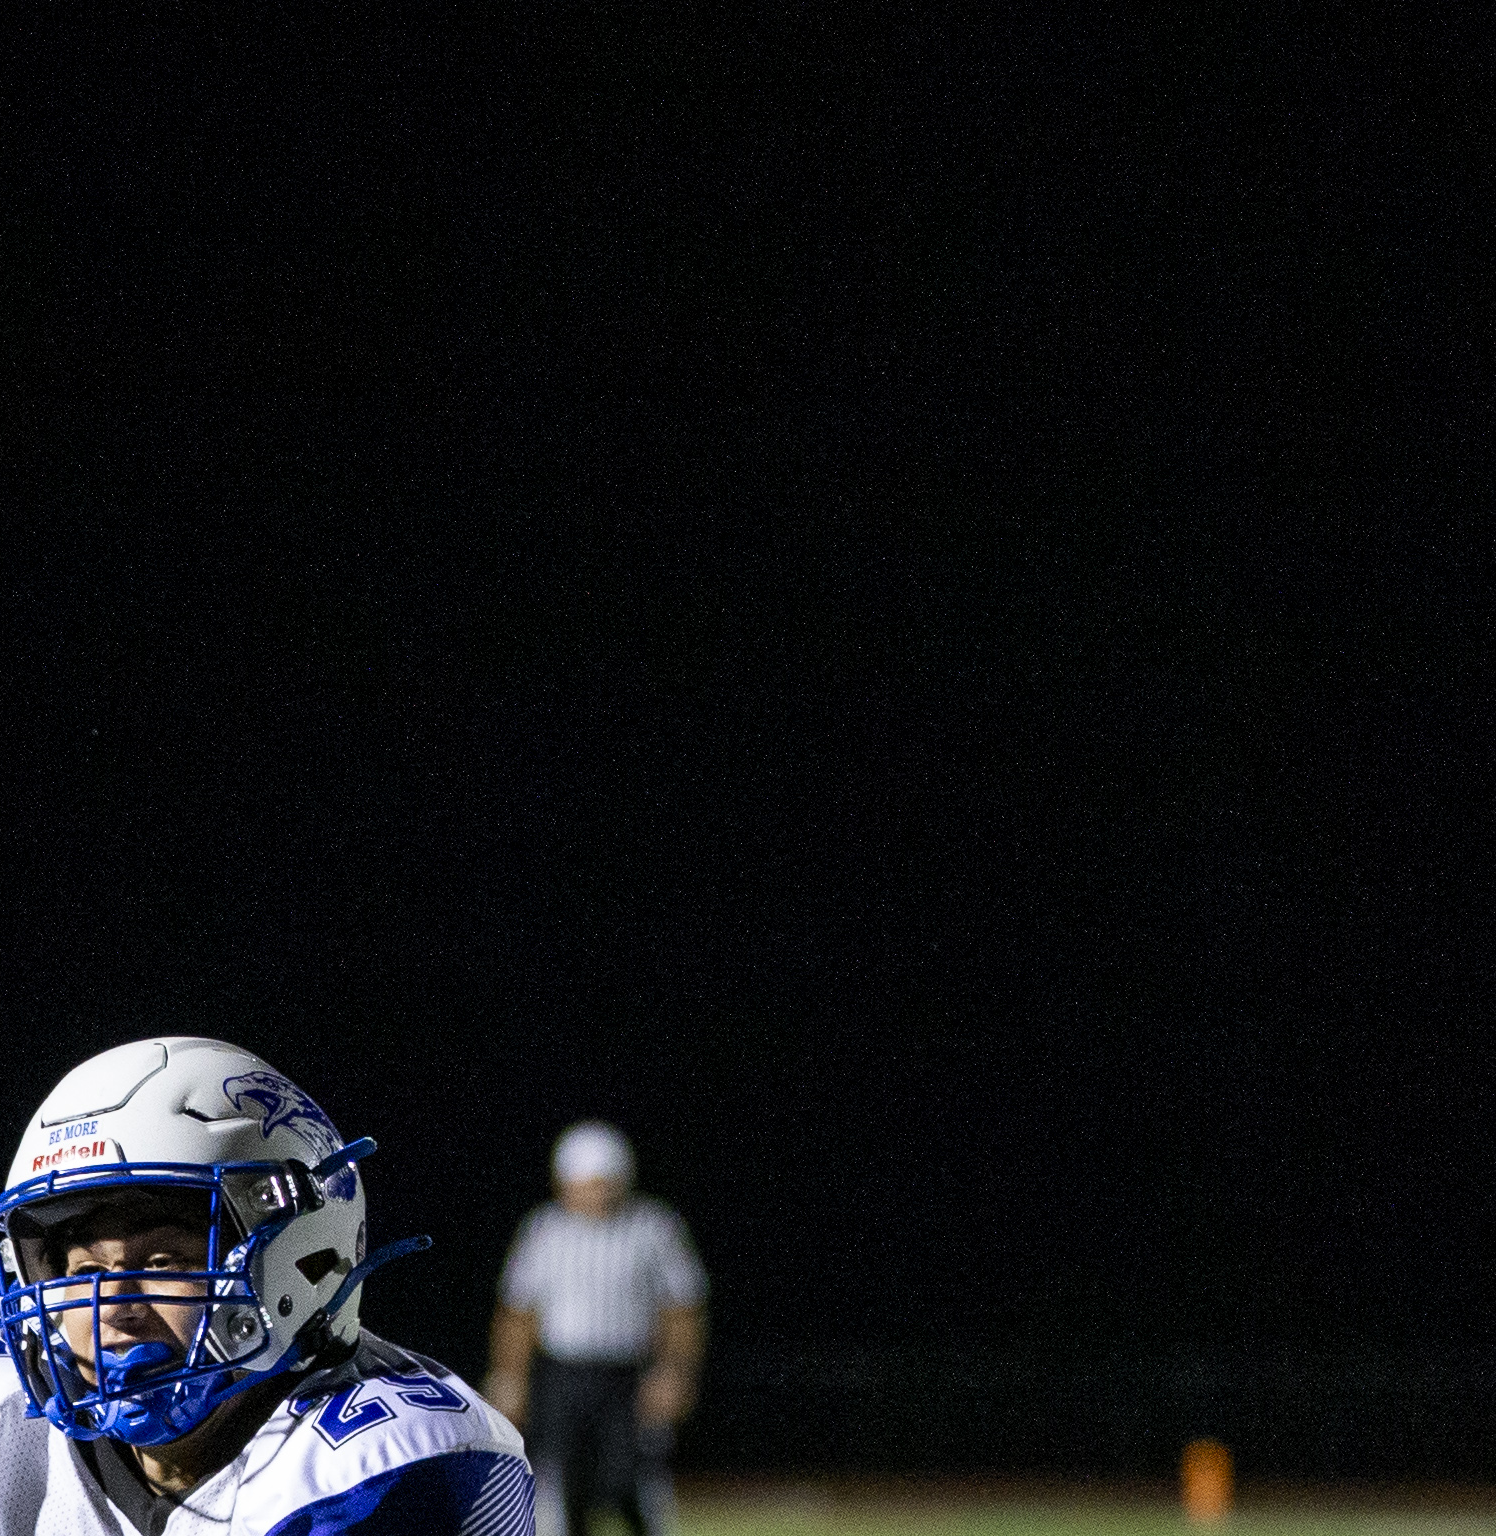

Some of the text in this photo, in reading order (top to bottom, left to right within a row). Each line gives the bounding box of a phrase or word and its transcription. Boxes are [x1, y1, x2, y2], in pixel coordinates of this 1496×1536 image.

[48, 1120, 99, 1146] BE MORE
[32, 1140, 106, 1172] Riddell
